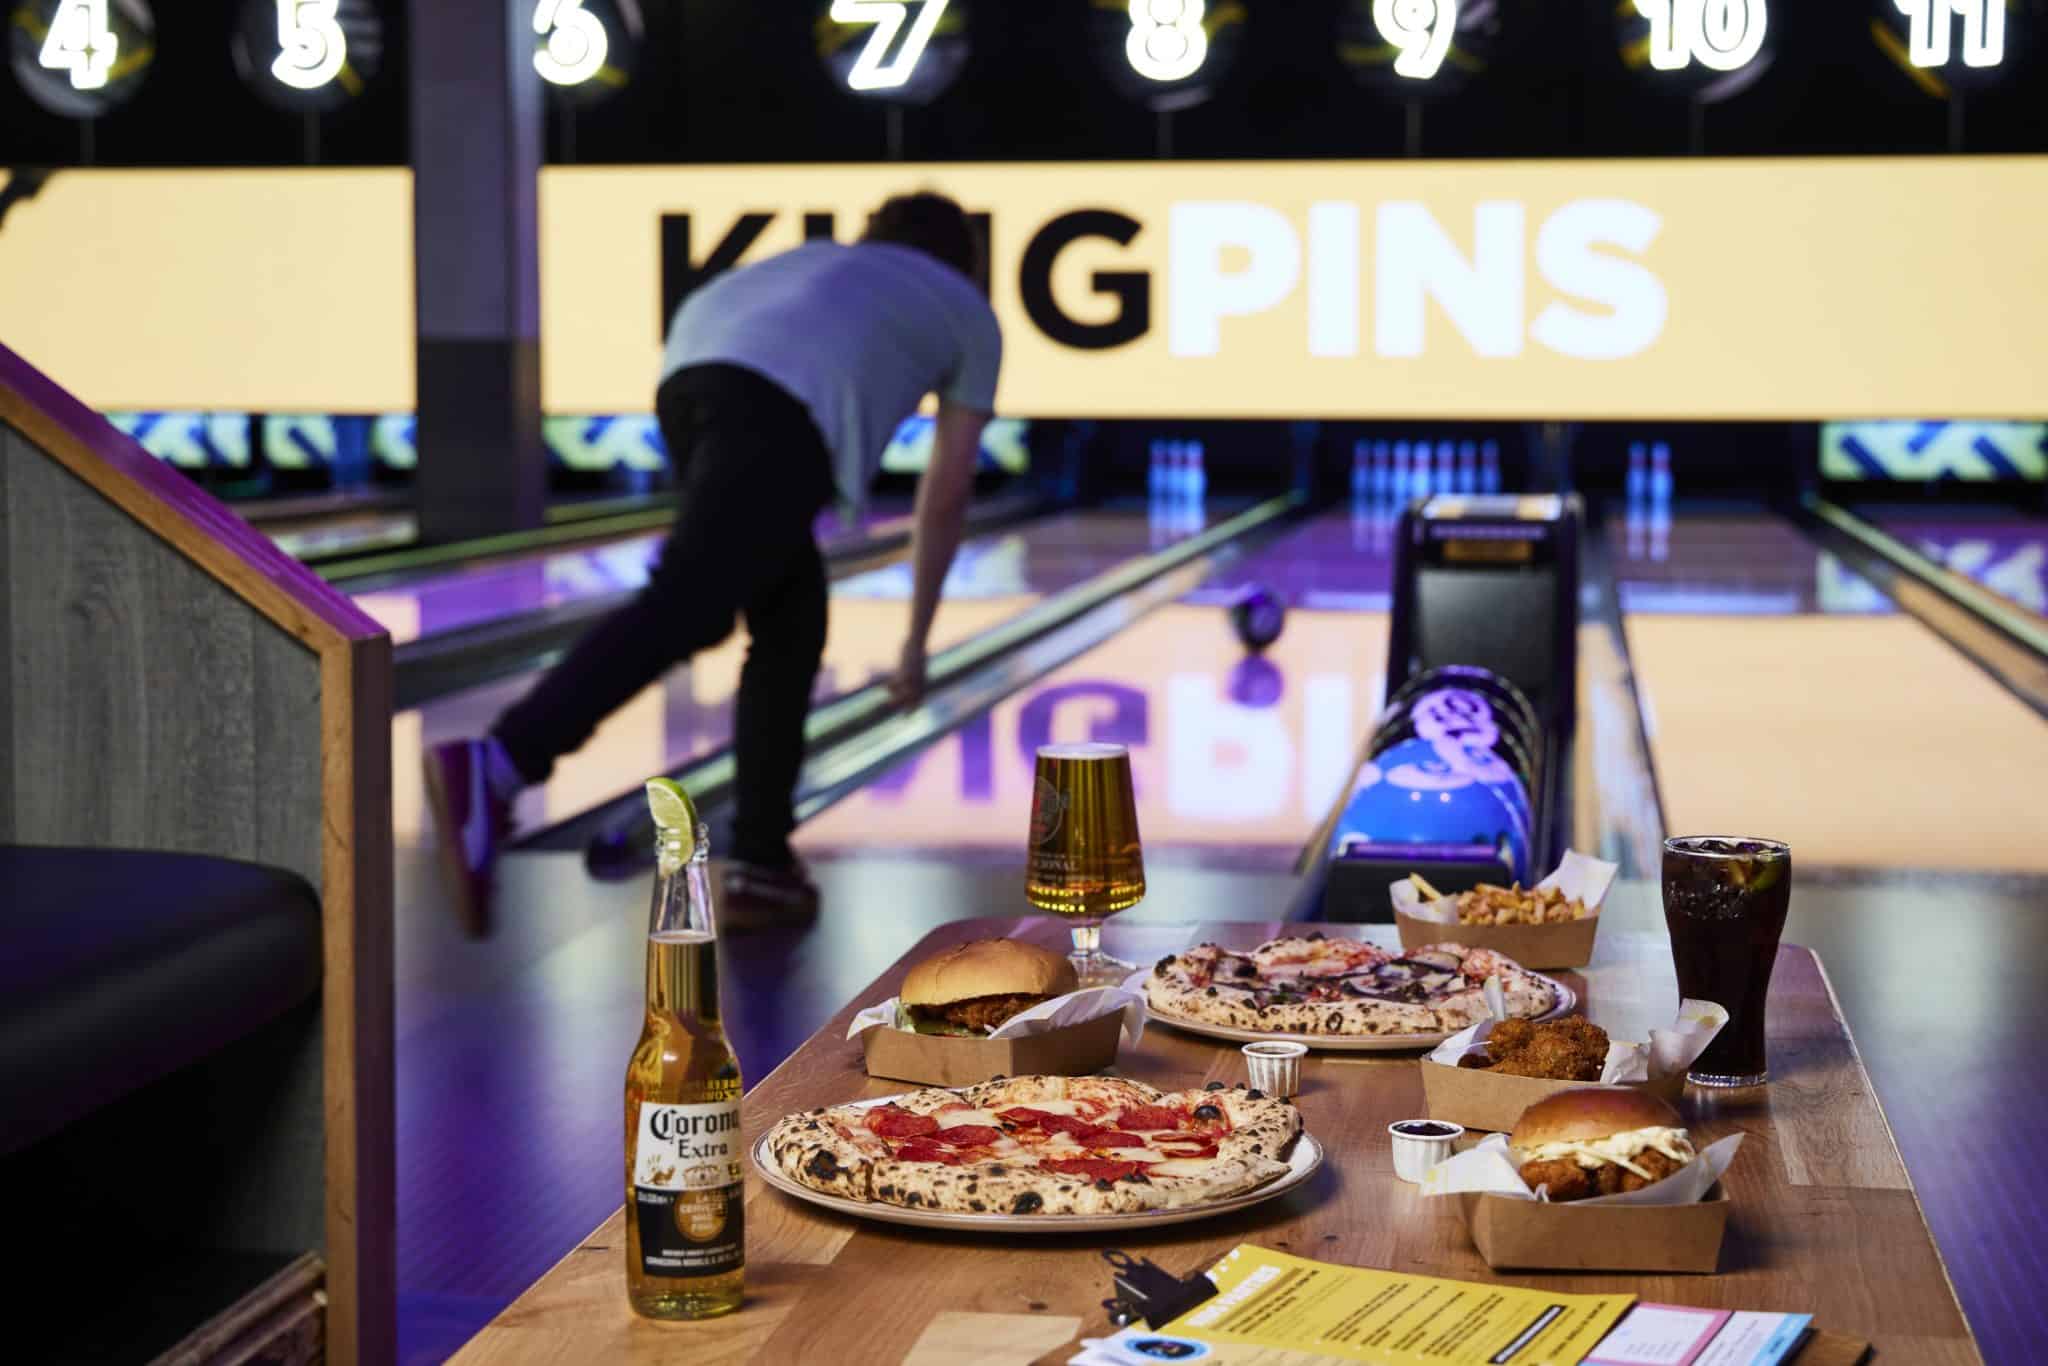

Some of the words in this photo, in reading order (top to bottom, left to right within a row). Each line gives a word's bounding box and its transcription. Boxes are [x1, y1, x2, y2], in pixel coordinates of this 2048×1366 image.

[39, 0, 118, 89] 4
[272, 0, 347, 89] 5
[532, 0, 608, 85] 6
[830, 0, 949, 90] 7
[1125, 0, 1208, 81] 8
[1373, 0, 1458, 79] 9
[1633, 0, 1767, 71] 10
[1893, 0, 2006, 68] 11
[659, 199, 1669, 360] KGPINS
[678, 1138, 729, 1159] Extra
